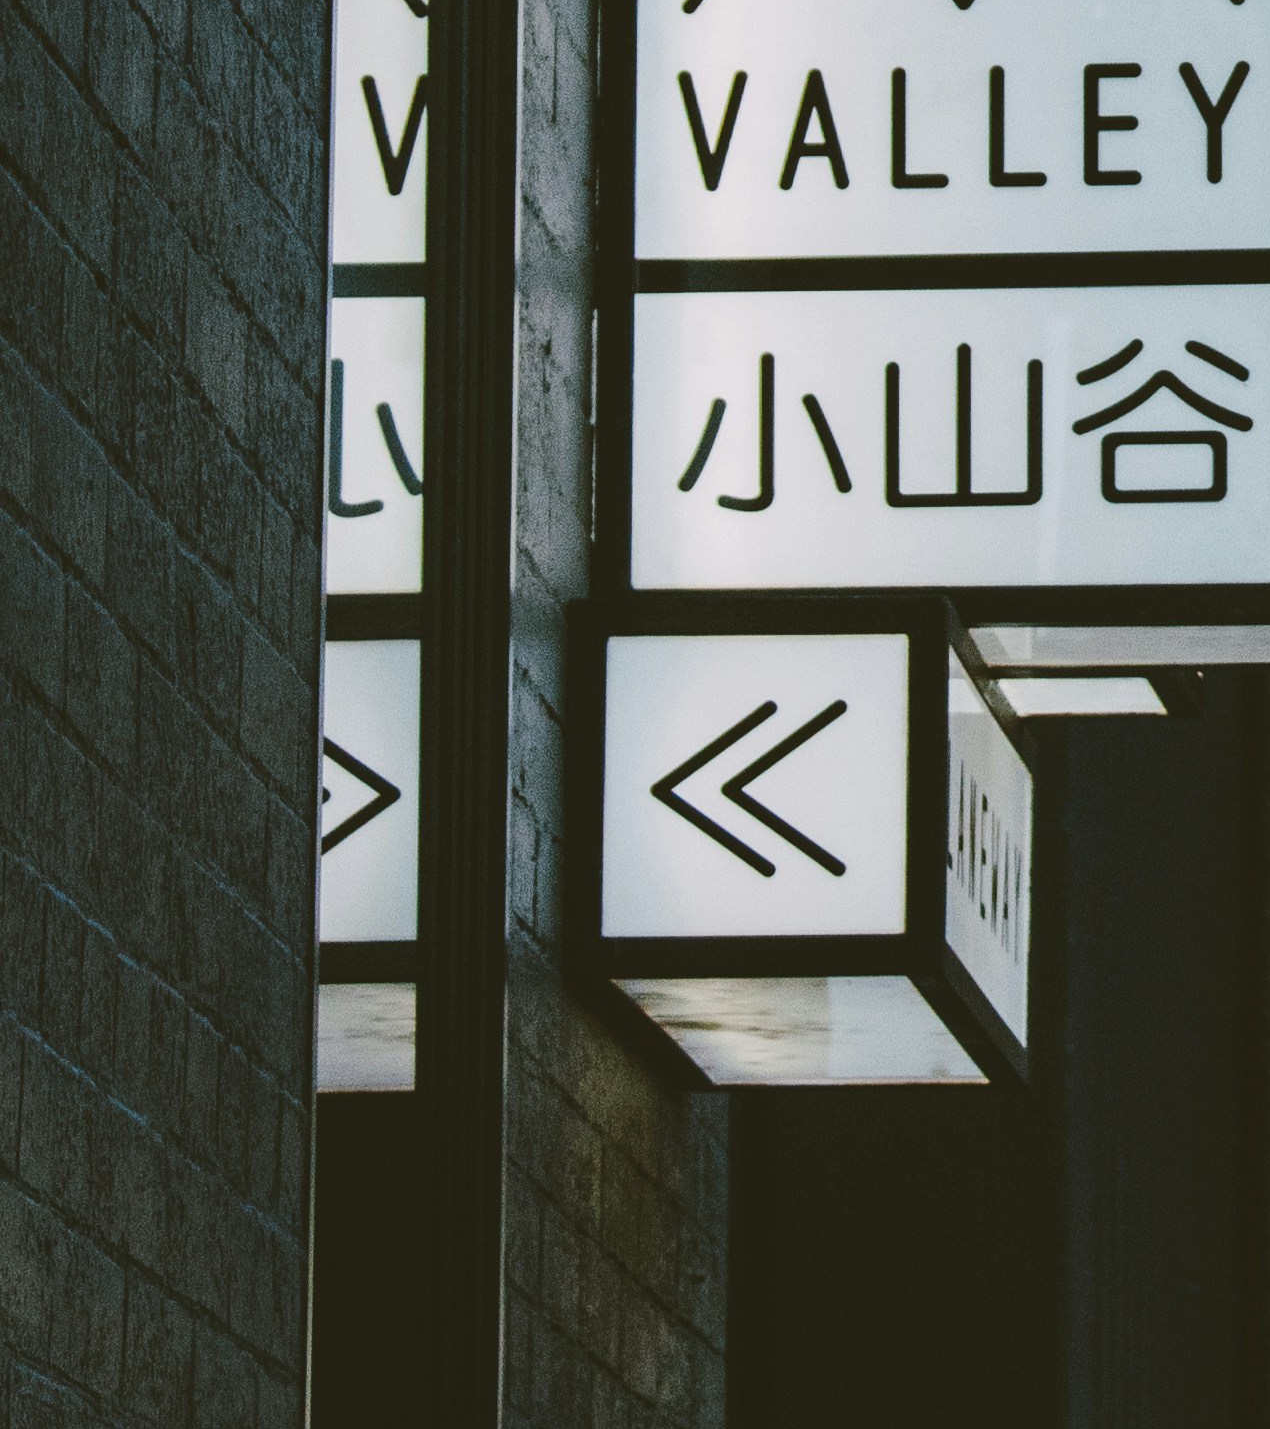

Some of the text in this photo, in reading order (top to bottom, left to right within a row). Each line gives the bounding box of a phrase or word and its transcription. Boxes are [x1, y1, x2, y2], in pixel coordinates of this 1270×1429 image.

[678, 61, 1250, 191] VALLEY
[679, 339, 1253, 512] 小山谷
[947, 760, 1022, 965] ANEWAY
